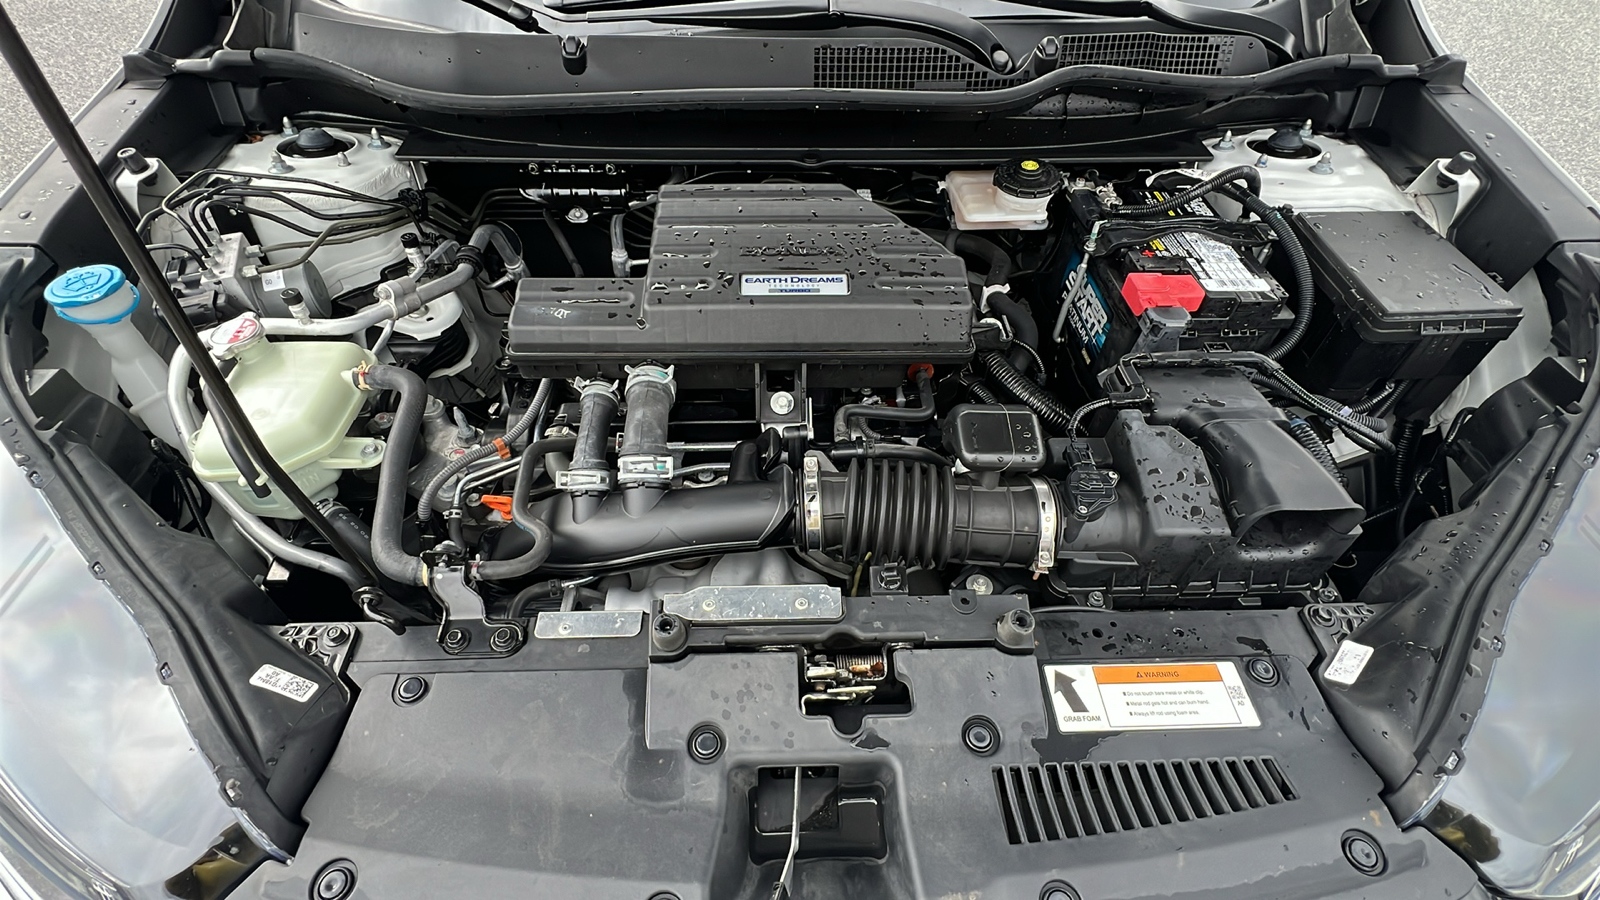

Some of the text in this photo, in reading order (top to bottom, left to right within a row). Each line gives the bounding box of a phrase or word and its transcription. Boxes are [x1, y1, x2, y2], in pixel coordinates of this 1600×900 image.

[790, 276, 844, 284] DREAMS
[1076, 264, 1108, 329] UPER
[1143, 670, 1180, 678] WARNING
